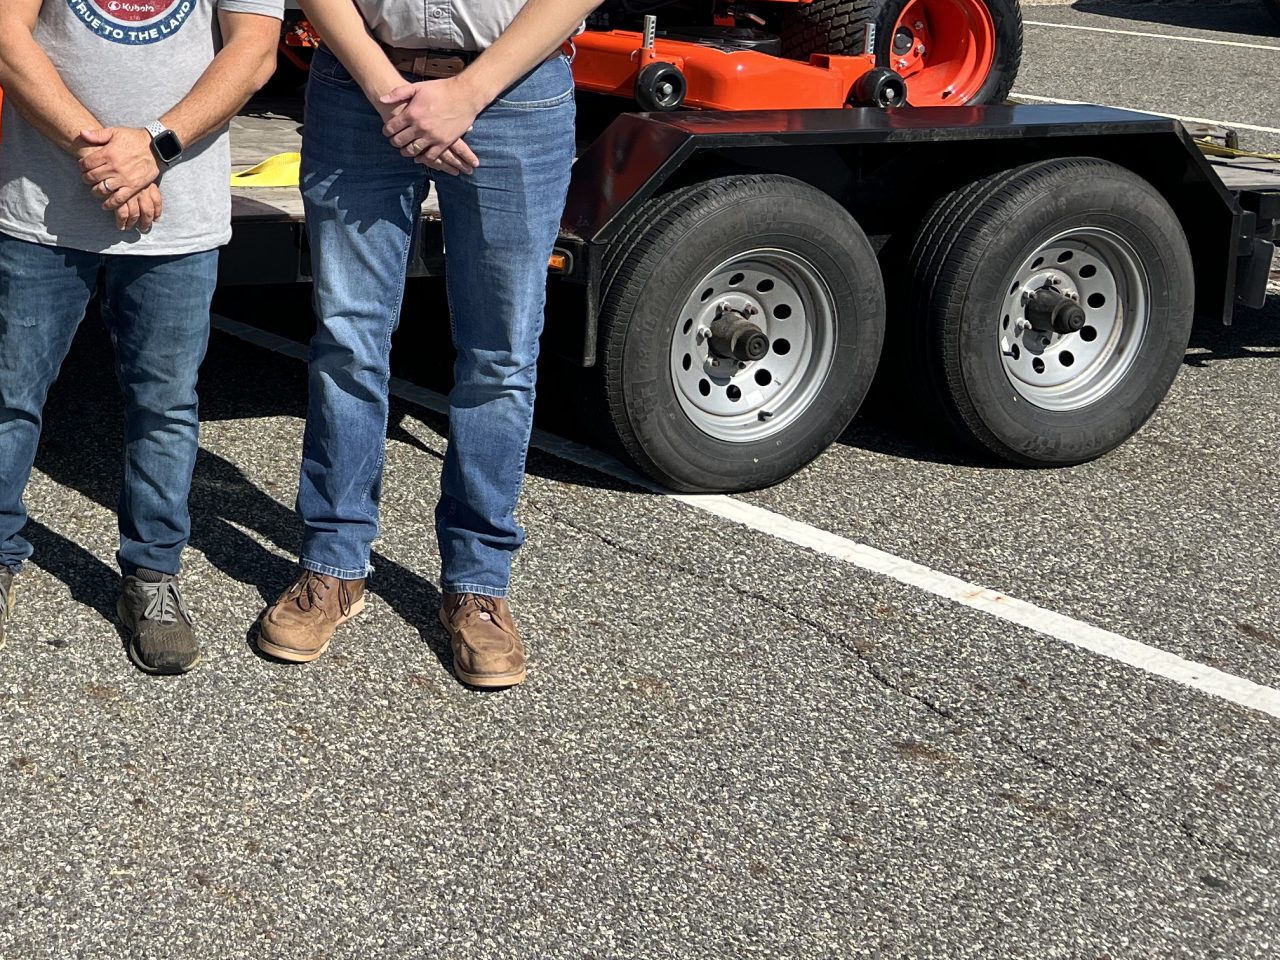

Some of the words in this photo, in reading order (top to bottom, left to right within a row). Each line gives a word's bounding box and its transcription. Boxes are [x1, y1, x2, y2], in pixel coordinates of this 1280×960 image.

[122, 2, 155, 12] Kubota
[103, 27, 124, 38] TO
[128, 29, 159, 41] THE
[162, 1, 191, 34] LAND
